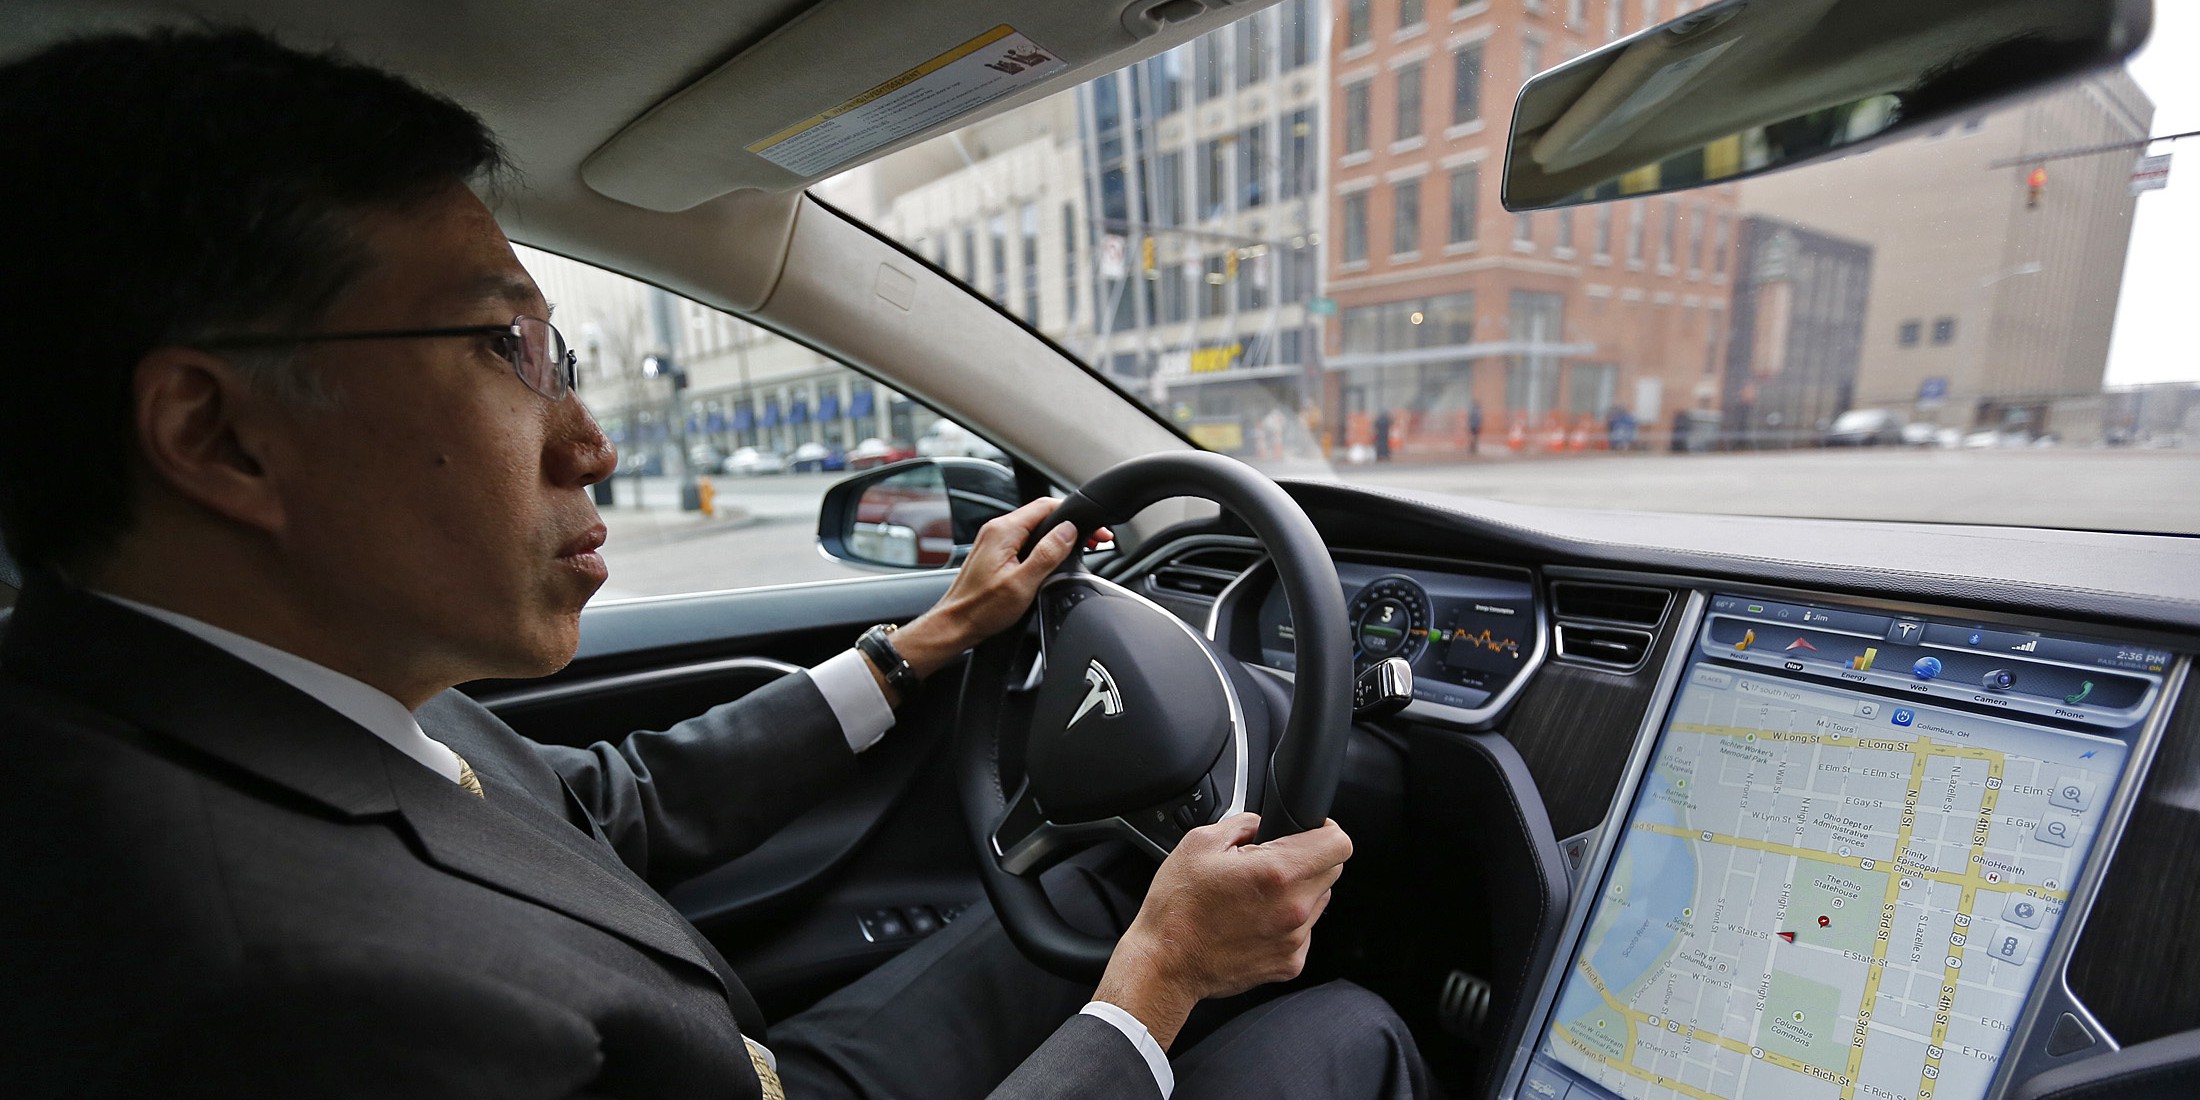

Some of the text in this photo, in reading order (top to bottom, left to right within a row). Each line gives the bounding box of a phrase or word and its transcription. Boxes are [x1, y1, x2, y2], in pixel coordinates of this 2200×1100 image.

[1381, 606, 1394, 622] 3
[1813, 614, 1829, 622] Jim
[1730, 652, 1749, 661] Media
[2116, 651, 2166, 664] 2:36 PM
[1787, 662, 1801, 670] Nav
[1841, 672, 1867, 682] Energy
[1760, 686, 1800, 700] south high
[1910, 684, 1928, 692] Web
[1974, 695, 2008, 706] Camera
[2055, 709, 2084, 720] Phone
[1832, 723, 1854, 733] Tours
[1917, 722, 1955, 736] Columbus,
[1784, 733, 1807, 745] Long
[1868, 740, 1894, 751] Long
[1897, 742, 1909, 751] St
[1720, 739, 1774, 757] Richter Worker's
[1720, 747, 1768, 765] Memorial Park
[1870, 769, 1888, 778] Elm
[1890, 771, 1900, 779] St
[1740, 780, 1752, 808] Front St
[1773, 786, 1781, 794] St
[1942, 766, 1961, 813] N Lazelle St
[2022, 786, 2043, 796] Elm
[1683, 801, 1697, 810] Park
[1854, 798, 1870, 808] Gay
[1904, 800, 1915, 815] 3rd
[1762, 812, 1780, 822] Lynn
[1782, 815, 1791, 823] St
[1797, 806, 1809, 824] High
[1823, 813, 1862, 829] Ohio Dept
[1902, 816, 1912, 827] St
[1795, 825, 1804, 835] St
[1813, 818, 1869, 839] Administrative
[1977, 817, 1989, 834] 4th
[2015, 819, 2036, 830] Gay
[1832, 833, 1866, 848] Services
[1974, 835, 1985, 846] St
[1901, 847, 1928, 860] Trinity
[1893, 864, 1924, 879] Church
[1896, 856, 1939, 874] Episcopal
[1972, 855, 2025, 876] OhioHealth
[1814, 880, 1858, 899] Statehouse
[1827, 874, 1861, 891] The Ohio
[2026, 888, 2037, 898] St
[1776, 891, 1790, 920] High St
[1672, 916, 1693, 929] Scioto
[1711, 904, 1724, 933] Front St
[1880, 913, 1893, 930] 3rd
[1680, 928, 1695, 938] Park
[1738, 926, 1759, 938] State
[1760, 930, 1769, 940] St
[1878, 930, 1889, 940] St
[1913, 923, 1927, 953] Lazelle
[1952, 936, 1964, 944] 62
[1622, 936, 1638, 958] Scioto
[1679, 952, 1712, 971] Columbus
[1694, 950, 1708, 960] City
[1851, 952, 1876, 965] State
[1878, 958, 1888, 968] St
[1911, 953, 1921, 963] St
[1580, 959, 1605, 993] W Rich St
[1633, 967, 1666, 999] Civic Center
[1702, 974, 1722, 987] Town
[1722, 980, 1732, 990] St
[1661, 980, 1676, 1016] Ludlow St
[1757, 981, 1769, 1002] High
[1755, 1002, 1765, 1012] St
[1938, 995, 1951, 1012] 4th
[1670, 1022, 1678, 1030] 62
[1935, 1014, 1948, 1025] St
[1990, 1020, 2012, 1032] Cha
[1774, 1017, 1814, 1039] Columbus
[1856, 1019, 1868, 1037] 3rd
[1683, 1025, 1696, 1054] Front St
[1771, 1026, 1810, 1047] Commons
[1853, 1037, 1863, 1048] St
[1571, 1038, 1606, 1063] W Main St
[1645, 1042, 1678, 1059] Cherry St
[1963, 1047, 1998, 1063] E Tow
[1803, 1065, 1850, 1086] E Rich St
[1925, 1068, 1936, 1076] 33
[1863, 1085, 1893, 1100] E Rich
